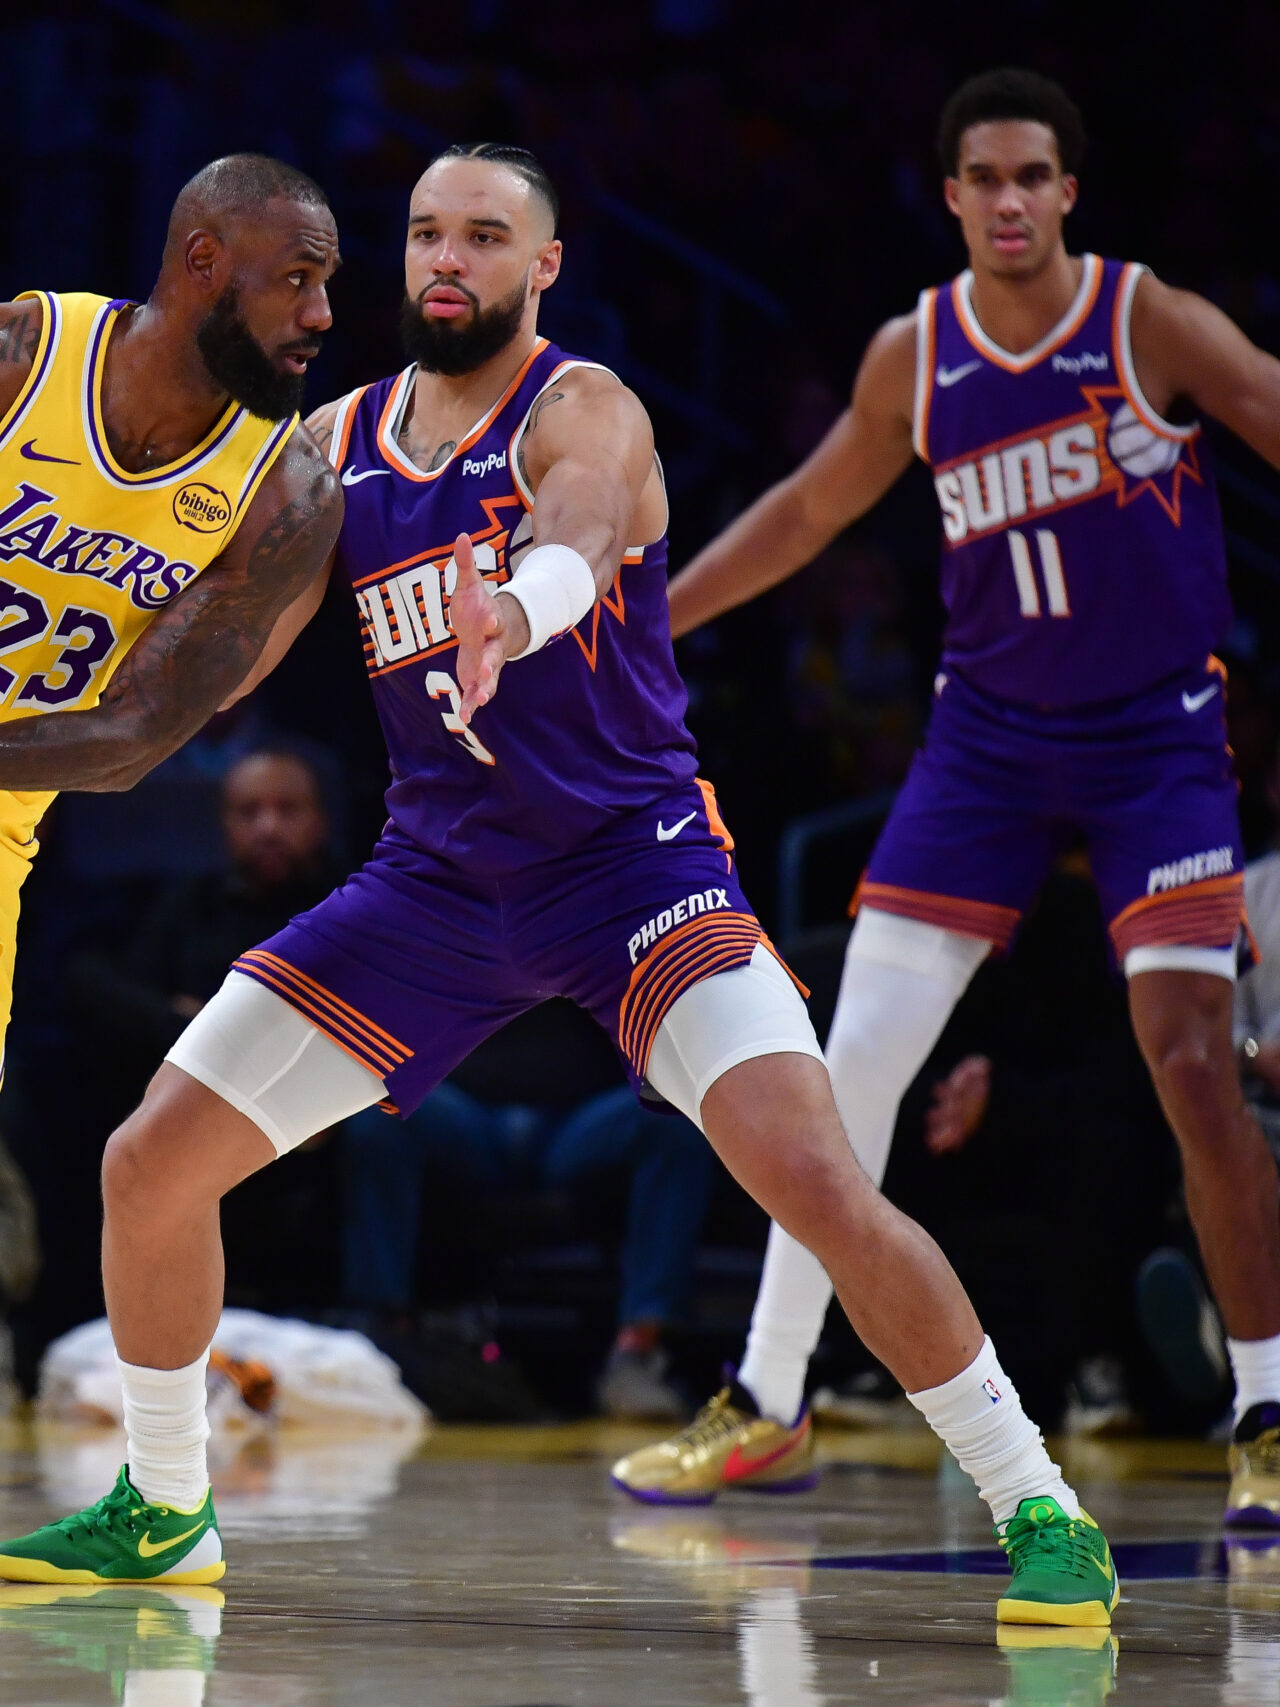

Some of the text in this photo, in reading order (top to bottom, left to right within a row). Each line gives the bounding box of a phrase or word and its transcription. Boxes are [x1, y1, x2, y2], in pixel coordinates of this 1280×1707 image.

[1052, 351, 1108, 376] PayPal
[462, 450, 506, 478] PayPal
[934, 421, 1101, 544] SUNS
[179, 491, 227, 522] bibigo
[1007, 528, 1071, 618] 11
[425, 671, 496, 766] 3
[627, 888, 732, 966] PHOENIX
